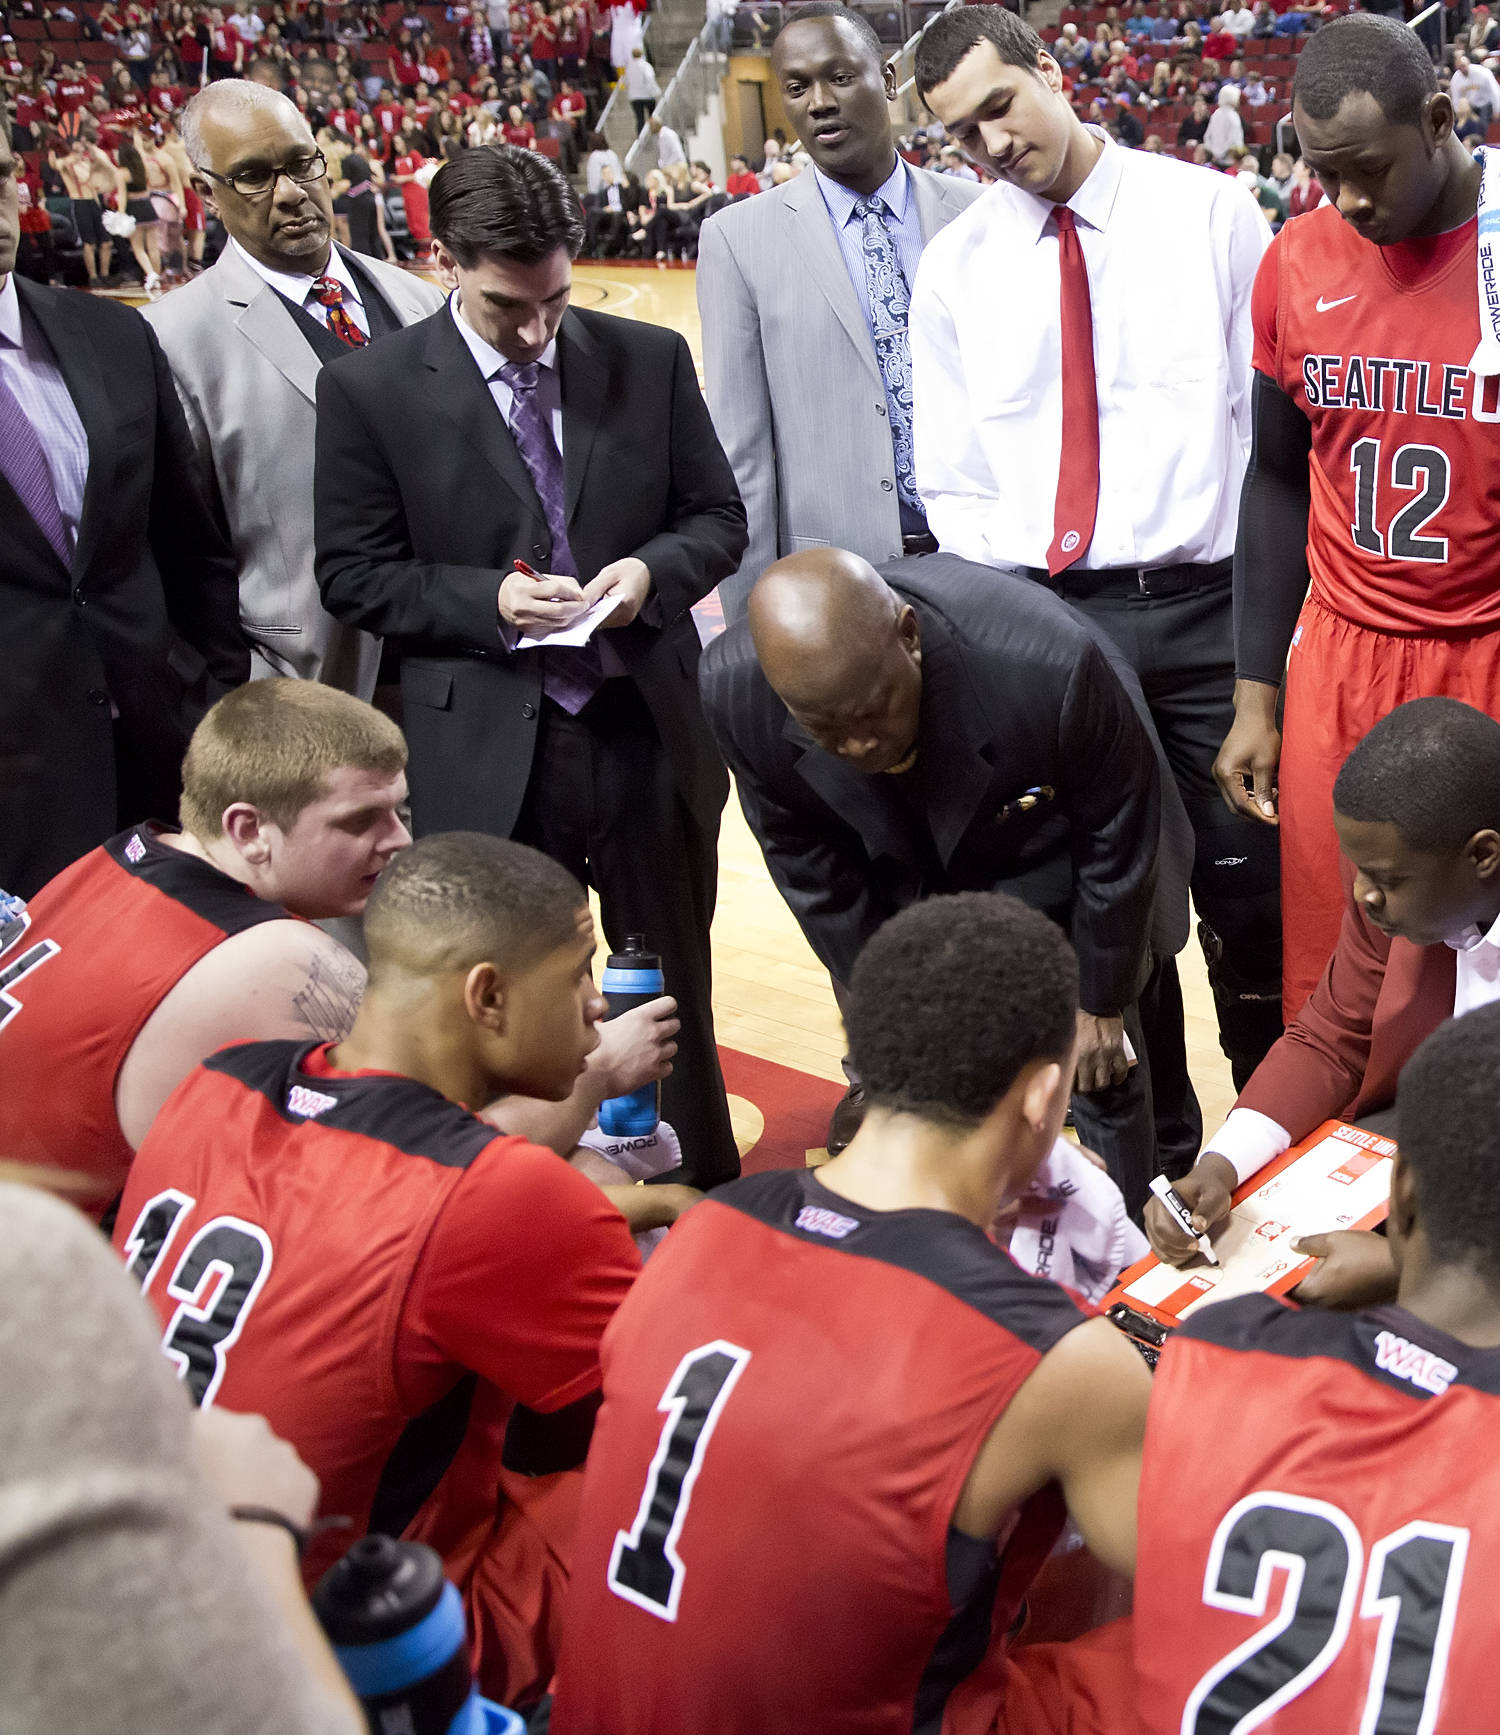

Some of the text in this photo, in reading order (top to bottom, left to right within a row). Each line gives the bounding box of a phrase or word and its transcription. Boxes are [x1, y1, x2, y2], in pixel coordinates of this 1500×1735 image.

[1350, 437, 1450, 563] 12
[124, 1188, 273, 1413] 13
[795, 1205, 860, 1239] WAC
[1374, 1331, 1459, 1396] WAC
[607, 1339, 752, 1622] 1
[1180, 1490, 1470, 1735] 21
